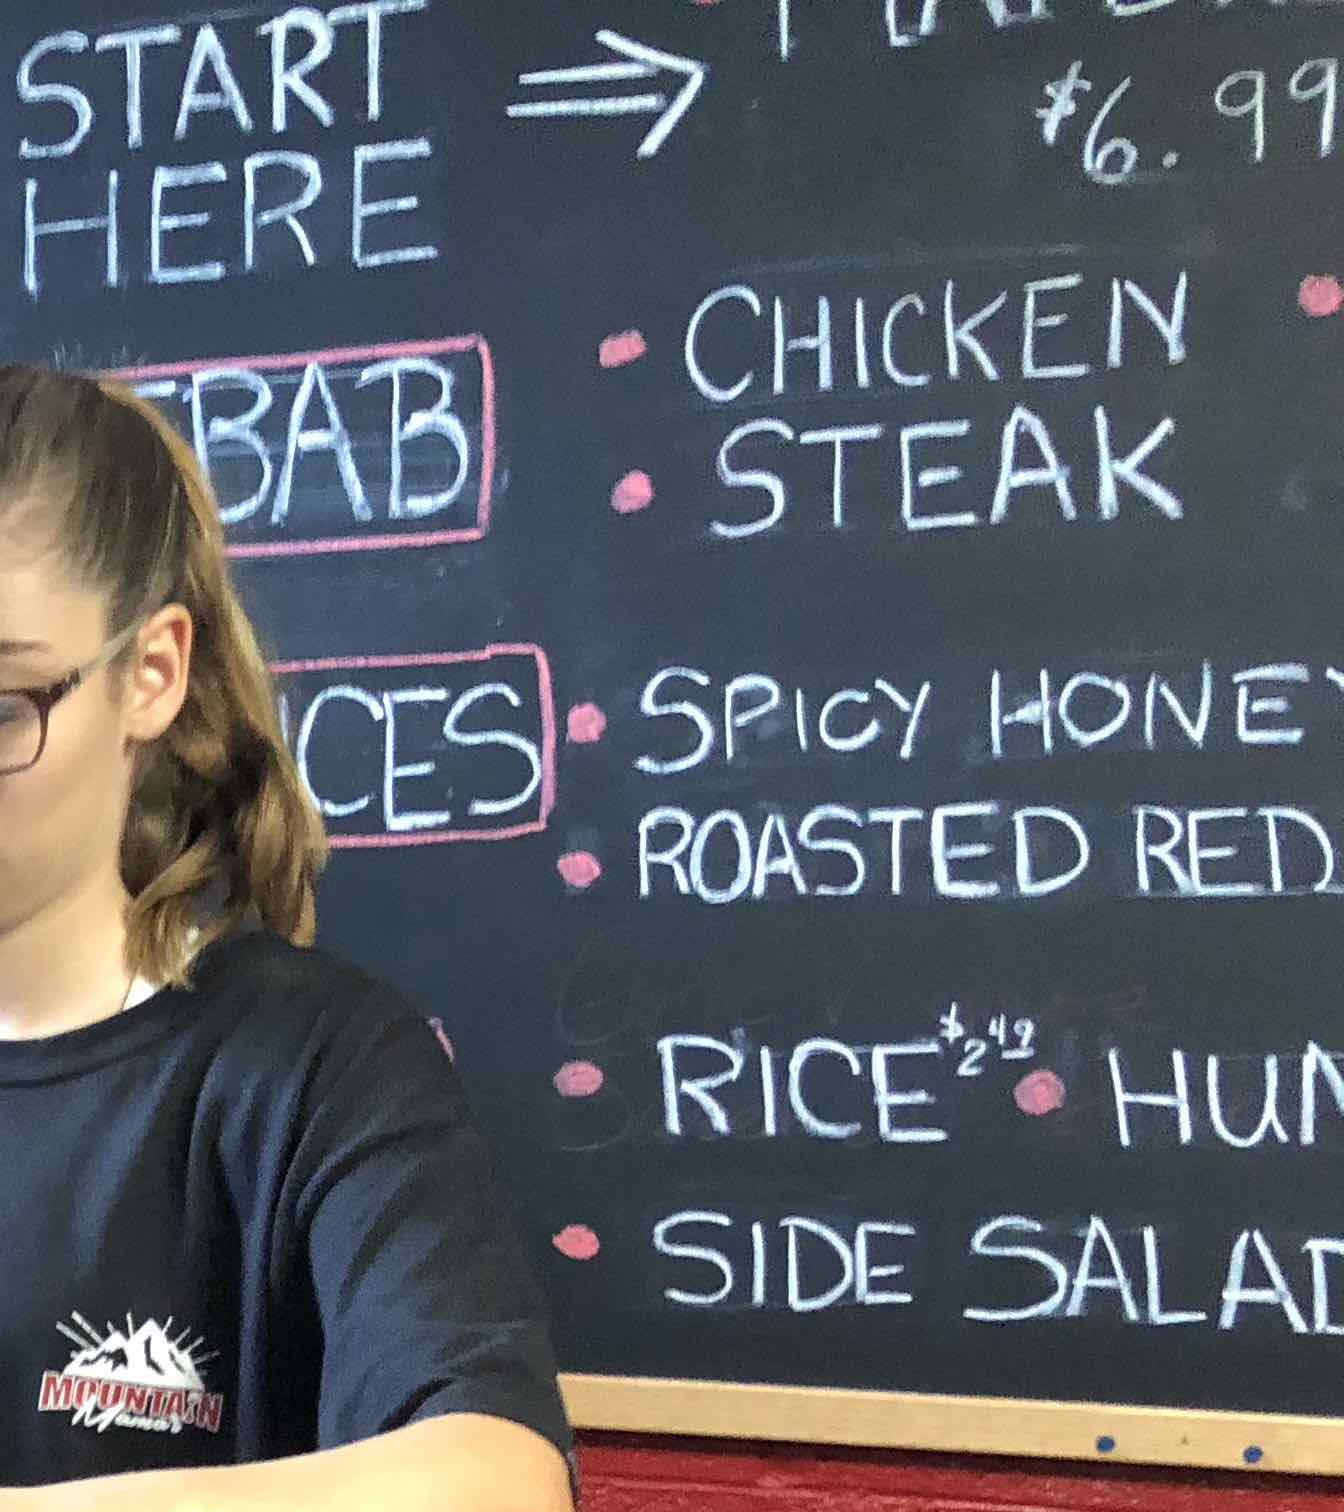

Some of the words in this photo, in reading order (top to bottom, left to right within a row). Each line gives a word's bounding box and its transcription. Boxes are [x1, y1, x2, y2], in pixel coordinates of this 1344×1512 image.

[17, 1, 421, 158] START
[24, 136, 438, 301] HERE
[684, 270, 1188, 402] CHICKEN
[129, 357, 469, 526] BAB
[710, 405, 1183, 539] STEAK
[634, 665, 931, 774] SPICY
[637, 803, 1089, 904] ROASTED
[1131, 804, 1338, 896] RED
[656, 1032, 949, 1143] RICE
[652, 1211, 915, 1312] SIDE
